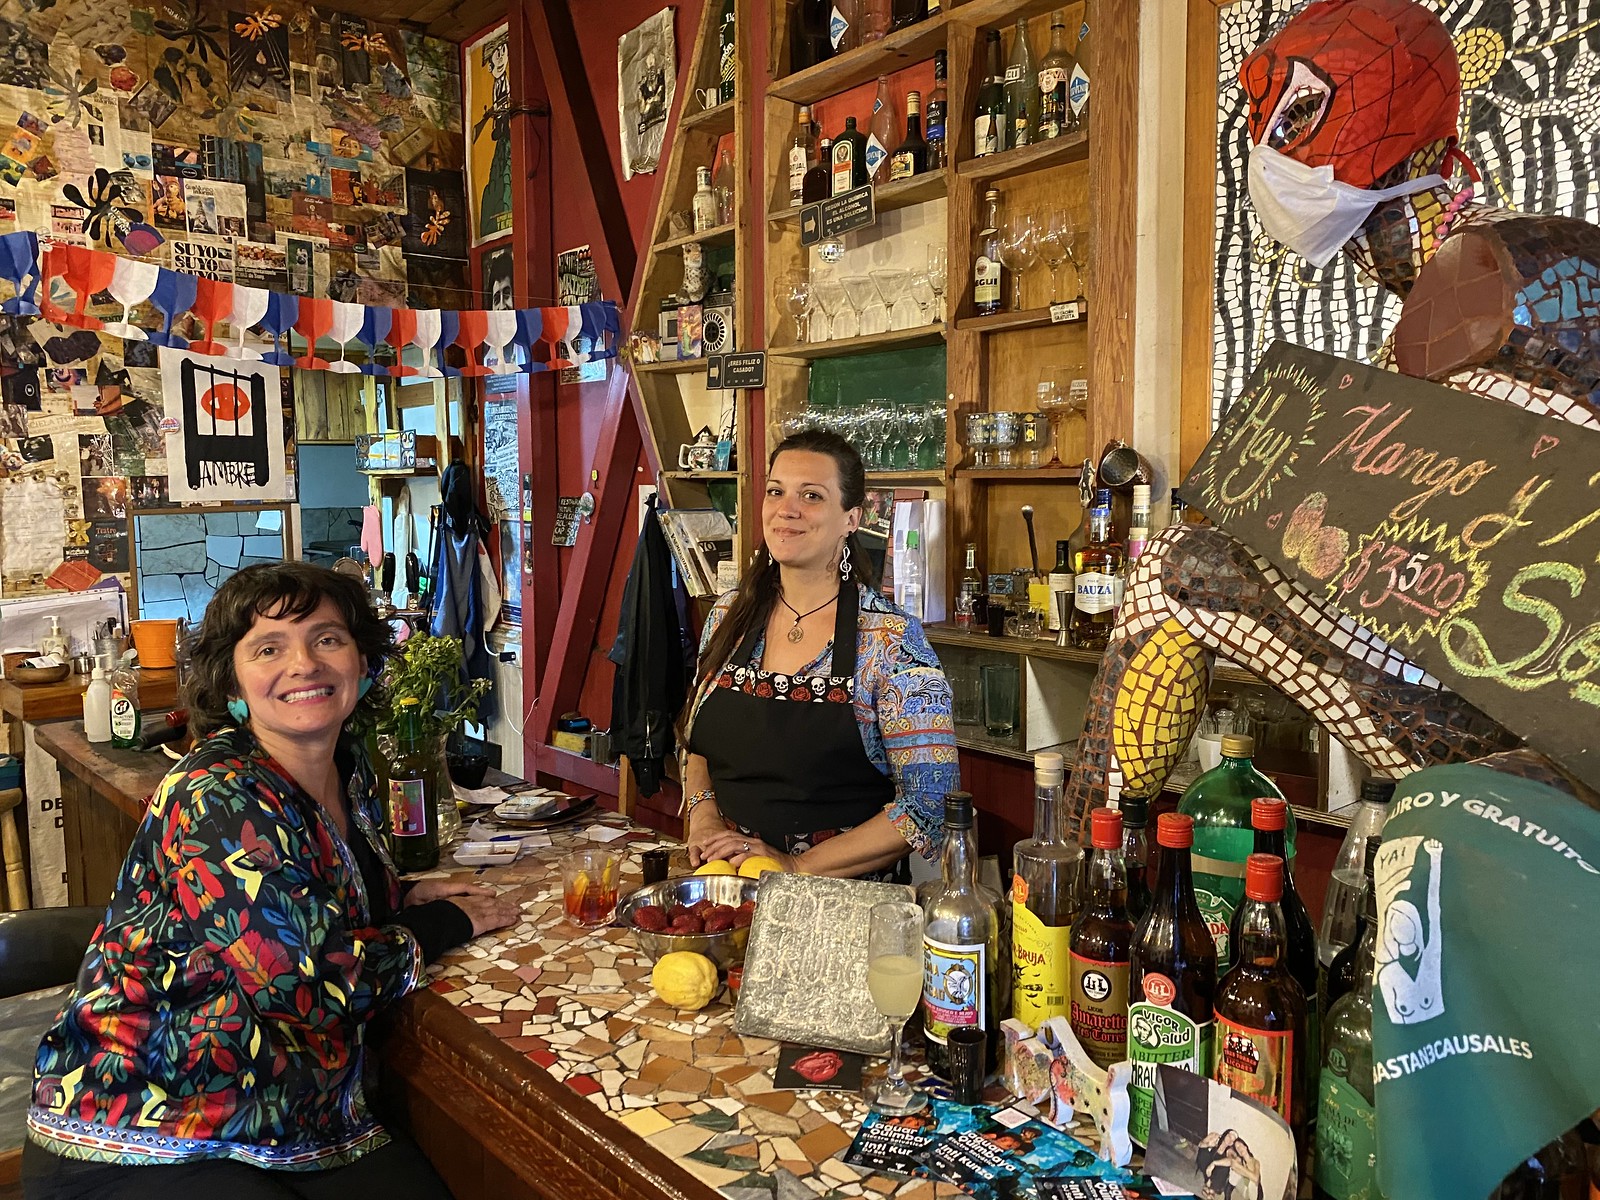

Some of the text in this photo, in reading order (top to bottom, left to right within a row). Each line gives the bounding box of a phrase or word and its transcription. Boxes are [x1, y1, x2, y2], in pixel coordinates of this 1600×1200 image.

[839, 201, 860, 214] ALCOHOL
[844, 206, 868, 218] SOLUCIÓN
[174, 241, 218, 258] SUYO
[174, 255, 219, 272] SUYO
[1220, 387, 1292, 505] Hay
[1317, 401, 1497, 521] Mango
[1337, 540, 1467, 610] $3500
[1077, 583, 1112, 595] BAUZÁ
[115, 701, 128, 714] Cif
[1440, 790, 1461, 808] Y
[1462, 799, 1600, 876] GRATUITO
[1017, 944, 1046, 967] BRUJA
[1071, 1000, 1128, 1030] Amaretto
[1142, 1008, 1179, 1032] VIGOR
[1091, 1027, 1127, 1044] Torres
[1152, 1024, 1192, 1049] Salud
[1138, 1049, 1190, 1063] BITTER
[1226, 1057, 1253, 1073] LICORES
[862, 1132, 889, 1141] Electro
[867, 1121, 918, 1135] Jaguar
[864, 1141, 887, 1151] Inti
[948, 1136, 969, 1151] Electro
[960, 1129, 1004, 1153] Jaguar
[940, 1144, 962, 1159] Inti
[958, 1156, 994, 1180] Kunza
[943, 1153, 955, 1162] Set
[958, 1135, 1016, 1172] Quimbaya
